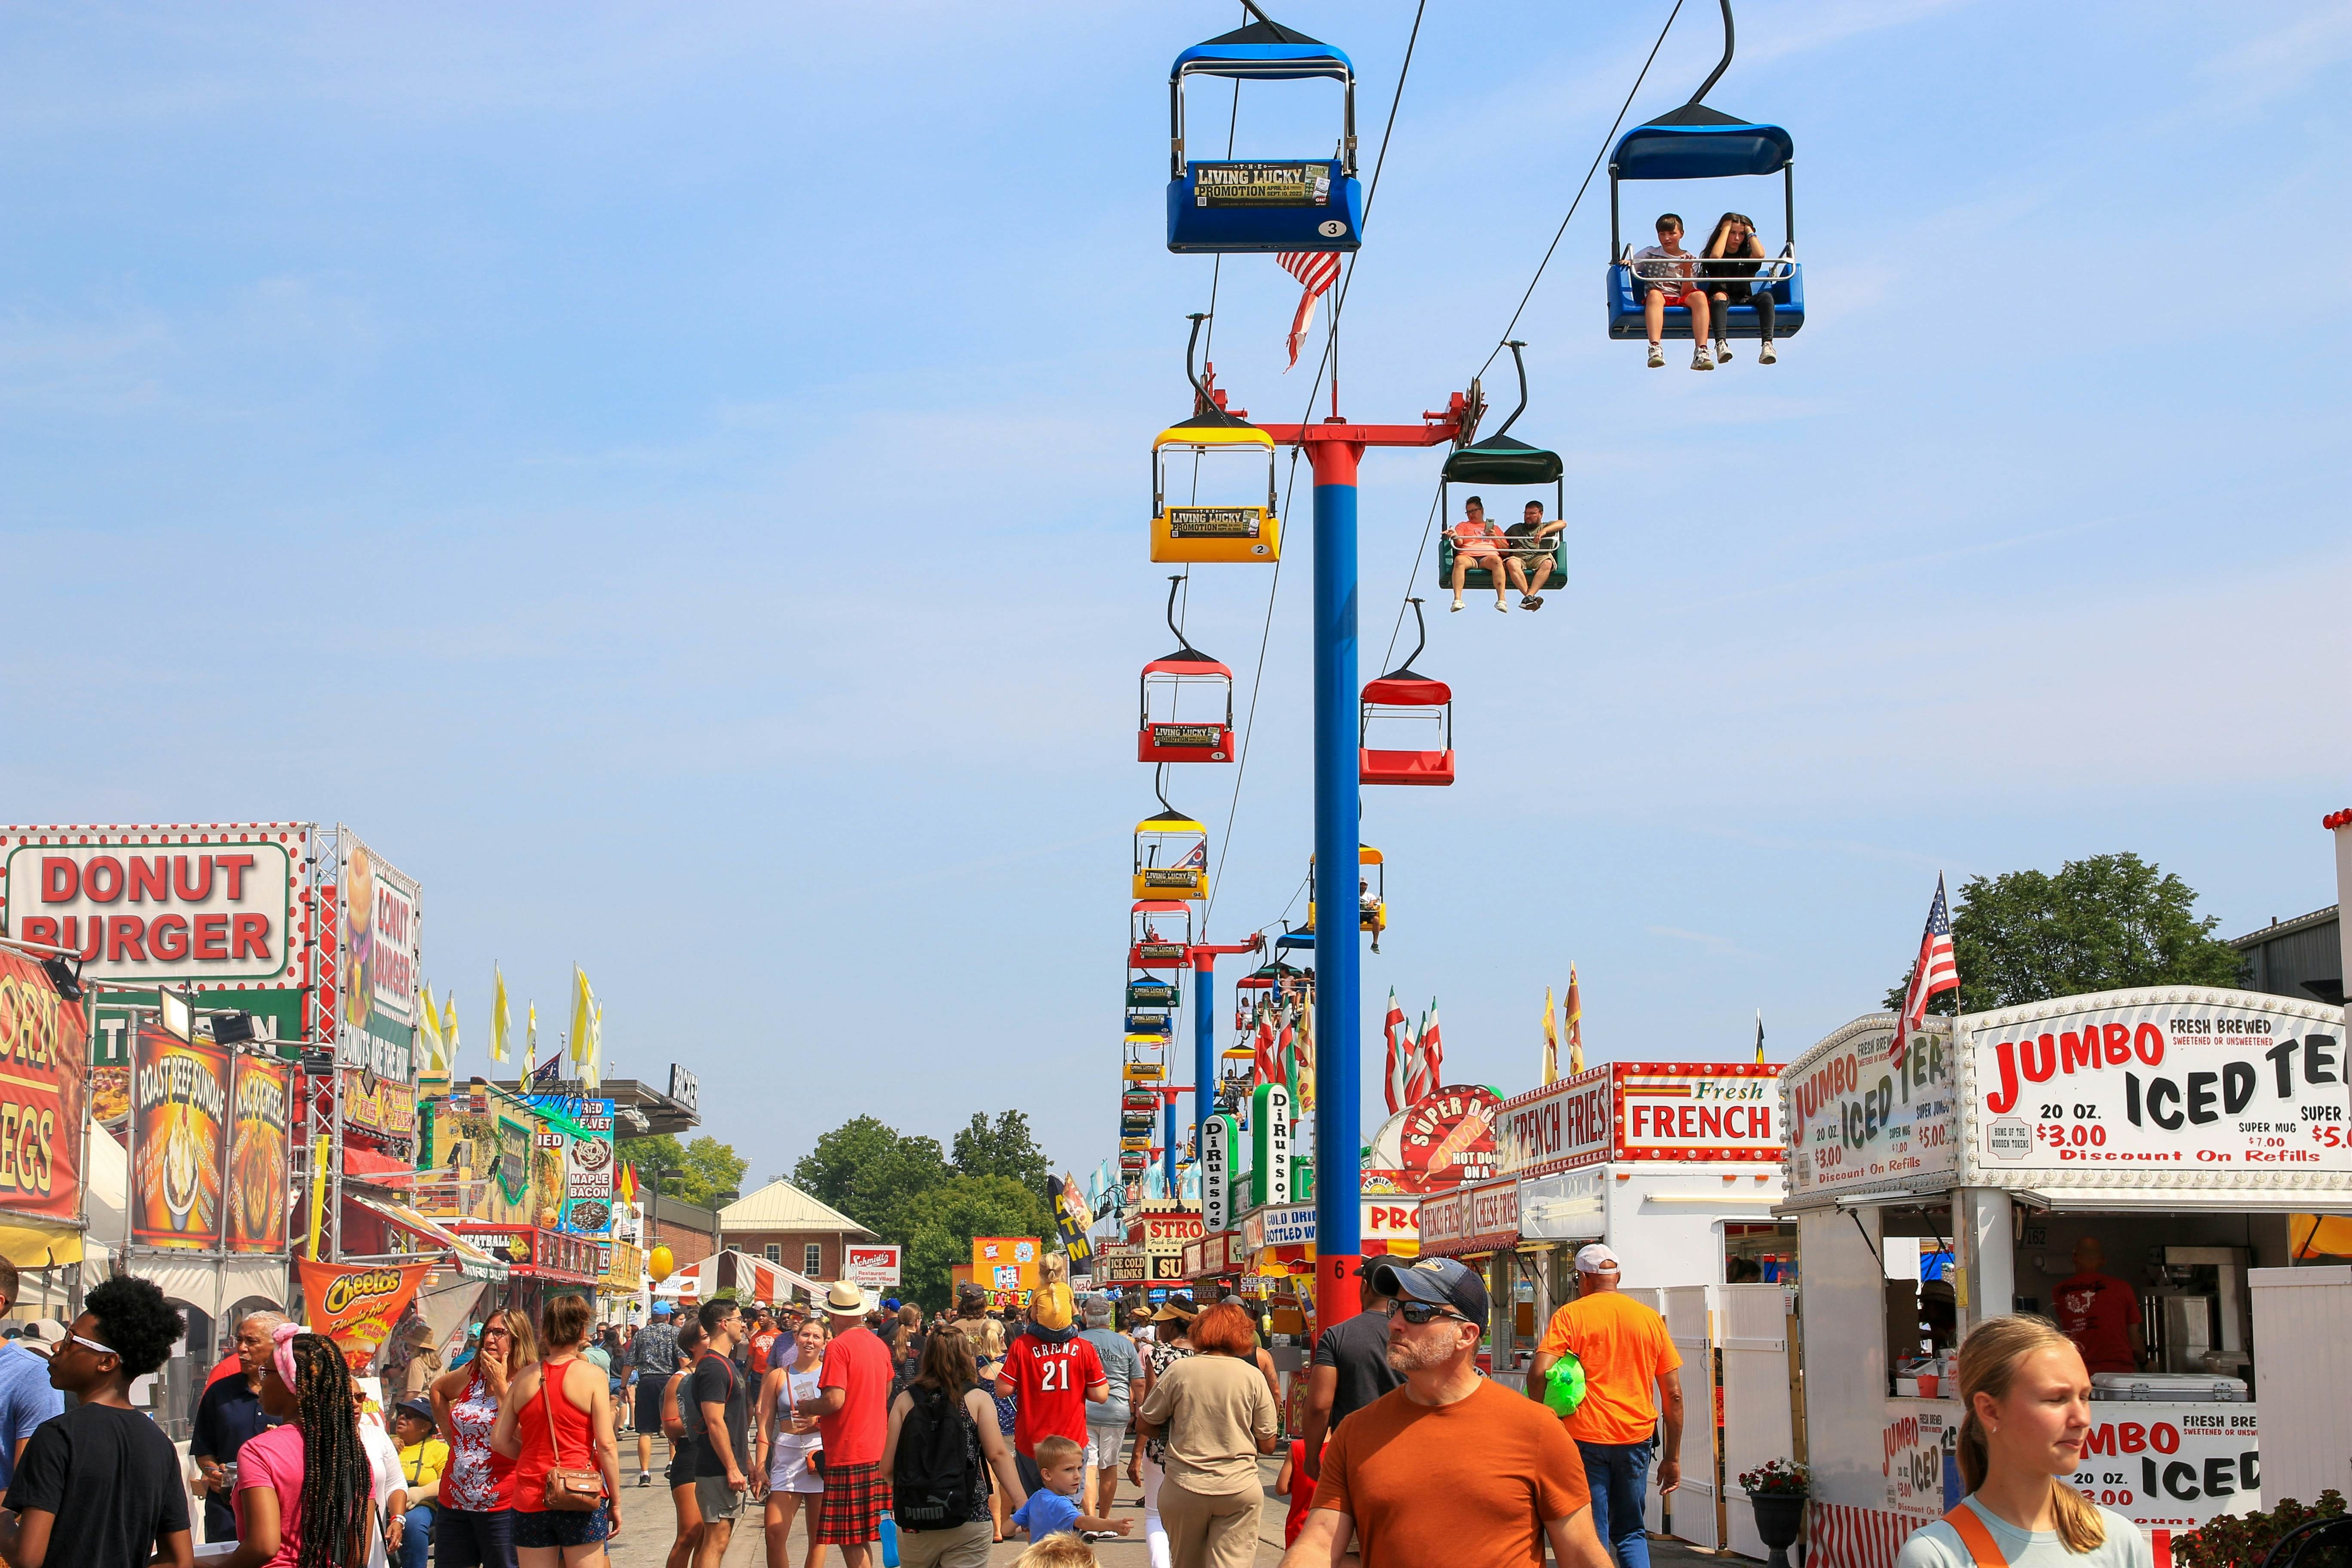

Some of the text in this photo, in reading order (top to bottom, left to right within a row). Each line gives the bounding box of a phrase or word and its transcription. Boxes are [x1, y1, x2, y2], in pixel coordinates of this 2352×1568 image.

[1198, 169, 1249, 184] LIVING
[1253, 169, 1302, 184] LUCKY
[1199, 186, 1265, 197] PROMOTION
[1328, 223, 1337, 234] 3
[1173, 513, 1241, 523] LIVING LUCKY
[41, 854, 254, 903] DONUT
[379, 887, 408, 948] DONUT
[21, 913, 271, 963] BURGER
[375, 939, 410, 1000] BURGER
[0, 975, 62, 1068] ORN
[2170, 1019, 2272, 1035] FRESH BREWED
[1858, 1039, 1874, 1057] FRESH
[2173, 1036, 2273, 1046] SWEETENED OR UNSWEETENED
[371, 1035, 383, 1075] ARE
[384, 1040, 396, 1079] THE
[1987, 1022, 2164, 1114] JUMBO
[140, 1055, 226, 1126] ROAST BEEF SUNDAE
[673, 1064, 698, 1111] BRICKER
[2125, 1034, 2348, 1130] ICED TE
[236, 1077, 254, 1115] MAC
[254, 1077, 260, 1112] &
[1694, 1082, 1763, 1101] Fresh
[1841, 1035, 1946, 1149] ICED TEA
[582, 1102, 603, 1114] RED
[1793, 1054, 1857, 1149] JUMBO
[1916, 1103, 1932, 1120] SUPER
[2041, 1103, 2101, 1119] 20 OZ.
[2301, 1106, 2342, 1121] SUPER
[1411, 1097, 1463, 1147] SUPER
[1514, 1102, 1560, 1162] FRENCH
[1568, 1082, 1606, 1148] FRIES
[1632, 1105, 1770, 1138] FRENCH
[2239, 1122, 2297, 1133] SUPER MUG
[1816, 1125, 1839, 1142] 20 OZ.
[1889, 1124, 1911, 1139] SUPER MUG
[1919, 1124, 1945, 1149] $5.00
[1994, 1127, 2025, 1136] HOME OF THE
[2037, 1123, 2107, 1148] $3.00
[0, 1102, 54, 1193] EGS
[537, 1134, 564, 1147] IED
[1992, 1139, 2029, 1148] WOODEN TOKENS
[2249, 1137, 2285, 1147] $7.00
[1452, 1152, 1474, 1165] HOT
[1815, 1145, 1841, 1169] $3.00
[2060, 1149, 2321, 1161] Discount On Refills
[1464, 1166, 1490, 1179] ON A
[1819, 1167, 1865, 1183] Discount
[1870, 1163, 1885, 1174] On
[1889, 1157, 1920, 1172] Refills
[571, 1174, 609, 1185] MAPLE
[1364, 1178, 1389, 1191] FAMILY
[570, 1187, 609, 1198] BACON
[1267, 1210, 1287, 1225] COLD
[1476, 1195, 1498, 1229] CHEESE
[1500, 1191, 1517, 1225] FRIES
[1055, 1194, 1090, 1262] ATM
[1425, 1205, 1443, 1237] FRENCH
[1445, 1202, 1459, 1234] FRIES
[1150, 1220, 1204, 1239] STRO
[1266, 1227, 1302, 1243] BOTTLED
[2027, 1231, 2046, 1244] 162
[460, 1234, 510, 1247] MEATBALL
[850, 1252, 889, 1272] Schmidt's
[1111, 1258, 1145, 1268] ICE COLD
[1334, 1260, 1344, 1280] 6
[996, 1269, 1018, 1284] ICEE
[1113, 1268, 1143, 1280] DRINKS
[325, 1269, 402, 1314] Cheetos
[353, 1295, 378, 1306] Crunchy
[369, 1302, 391, 1317] Hot
[364, 1330, 379, 1339] FOOD
[1032, 1342, 1079, 1359] GREENE
[1041, 1359, 1069, 1391] 21
[1919, 1414, 1942, 1425] FRESH BREWED
[2184, 1415, 2224, 1427] FRESH
[1883, 1417, 1919, 1478] JUMBO
[2080, 1421, 2180, 1460] MBO
[1898, 1466, 1902, 1476] 20
[1910, 1445, 1938, 1492] ICED
[2141, 1451, 2260, 1501] ICED
[2074, 1473, 2128, 1485] 20 OZ.
[1898, 1481, 1911, 1498] $3.00
[904, 1506, 944, 1520] PUMA
[1898, 1503, 1935, 1515] Discount On
